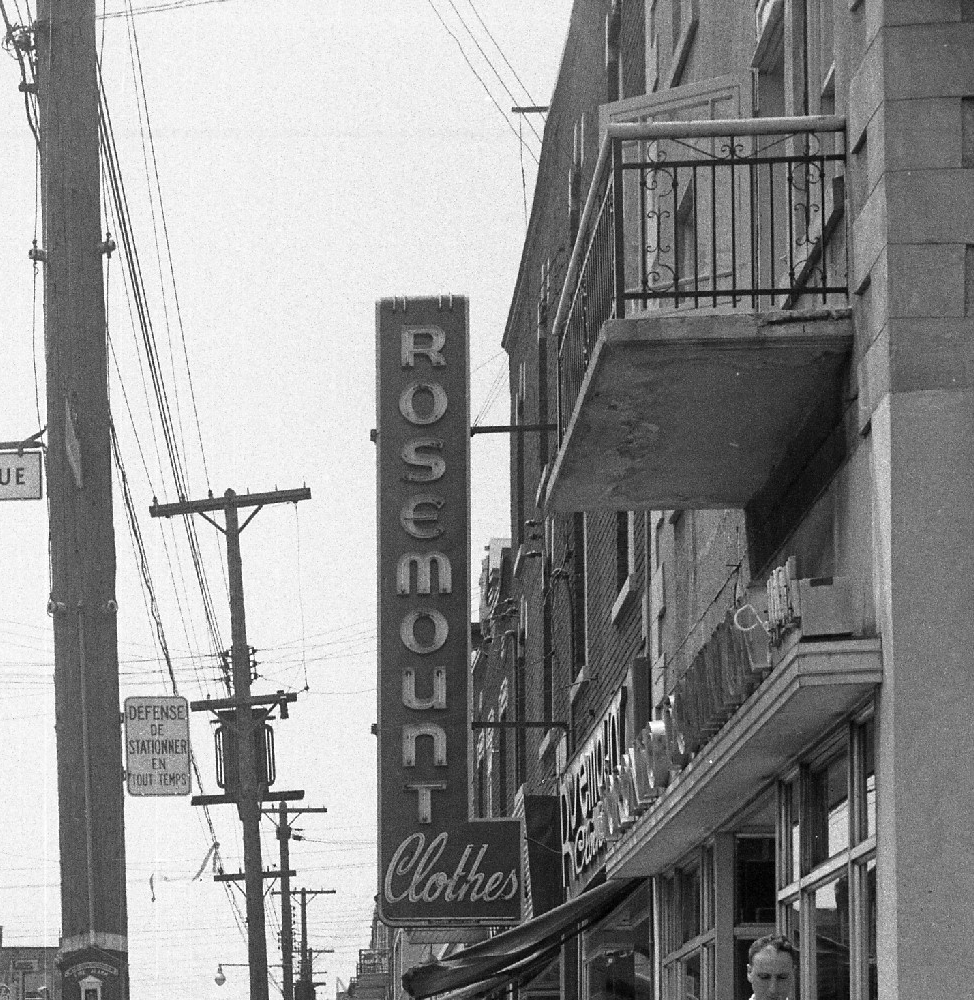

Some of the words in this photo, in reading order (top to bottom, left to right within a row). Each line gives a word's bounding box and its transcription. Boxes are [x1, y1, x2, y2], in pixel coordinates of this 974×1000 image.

[151, 724, 164, 736] DE
[129, 739, 187, 754] STATIONNER
[152, 758, 166, 770] EN
[131, 773, 153, 786] TOUT
[159, 773, 187, 786] TEMPS
[384, 831, 519, 903] Clothes
